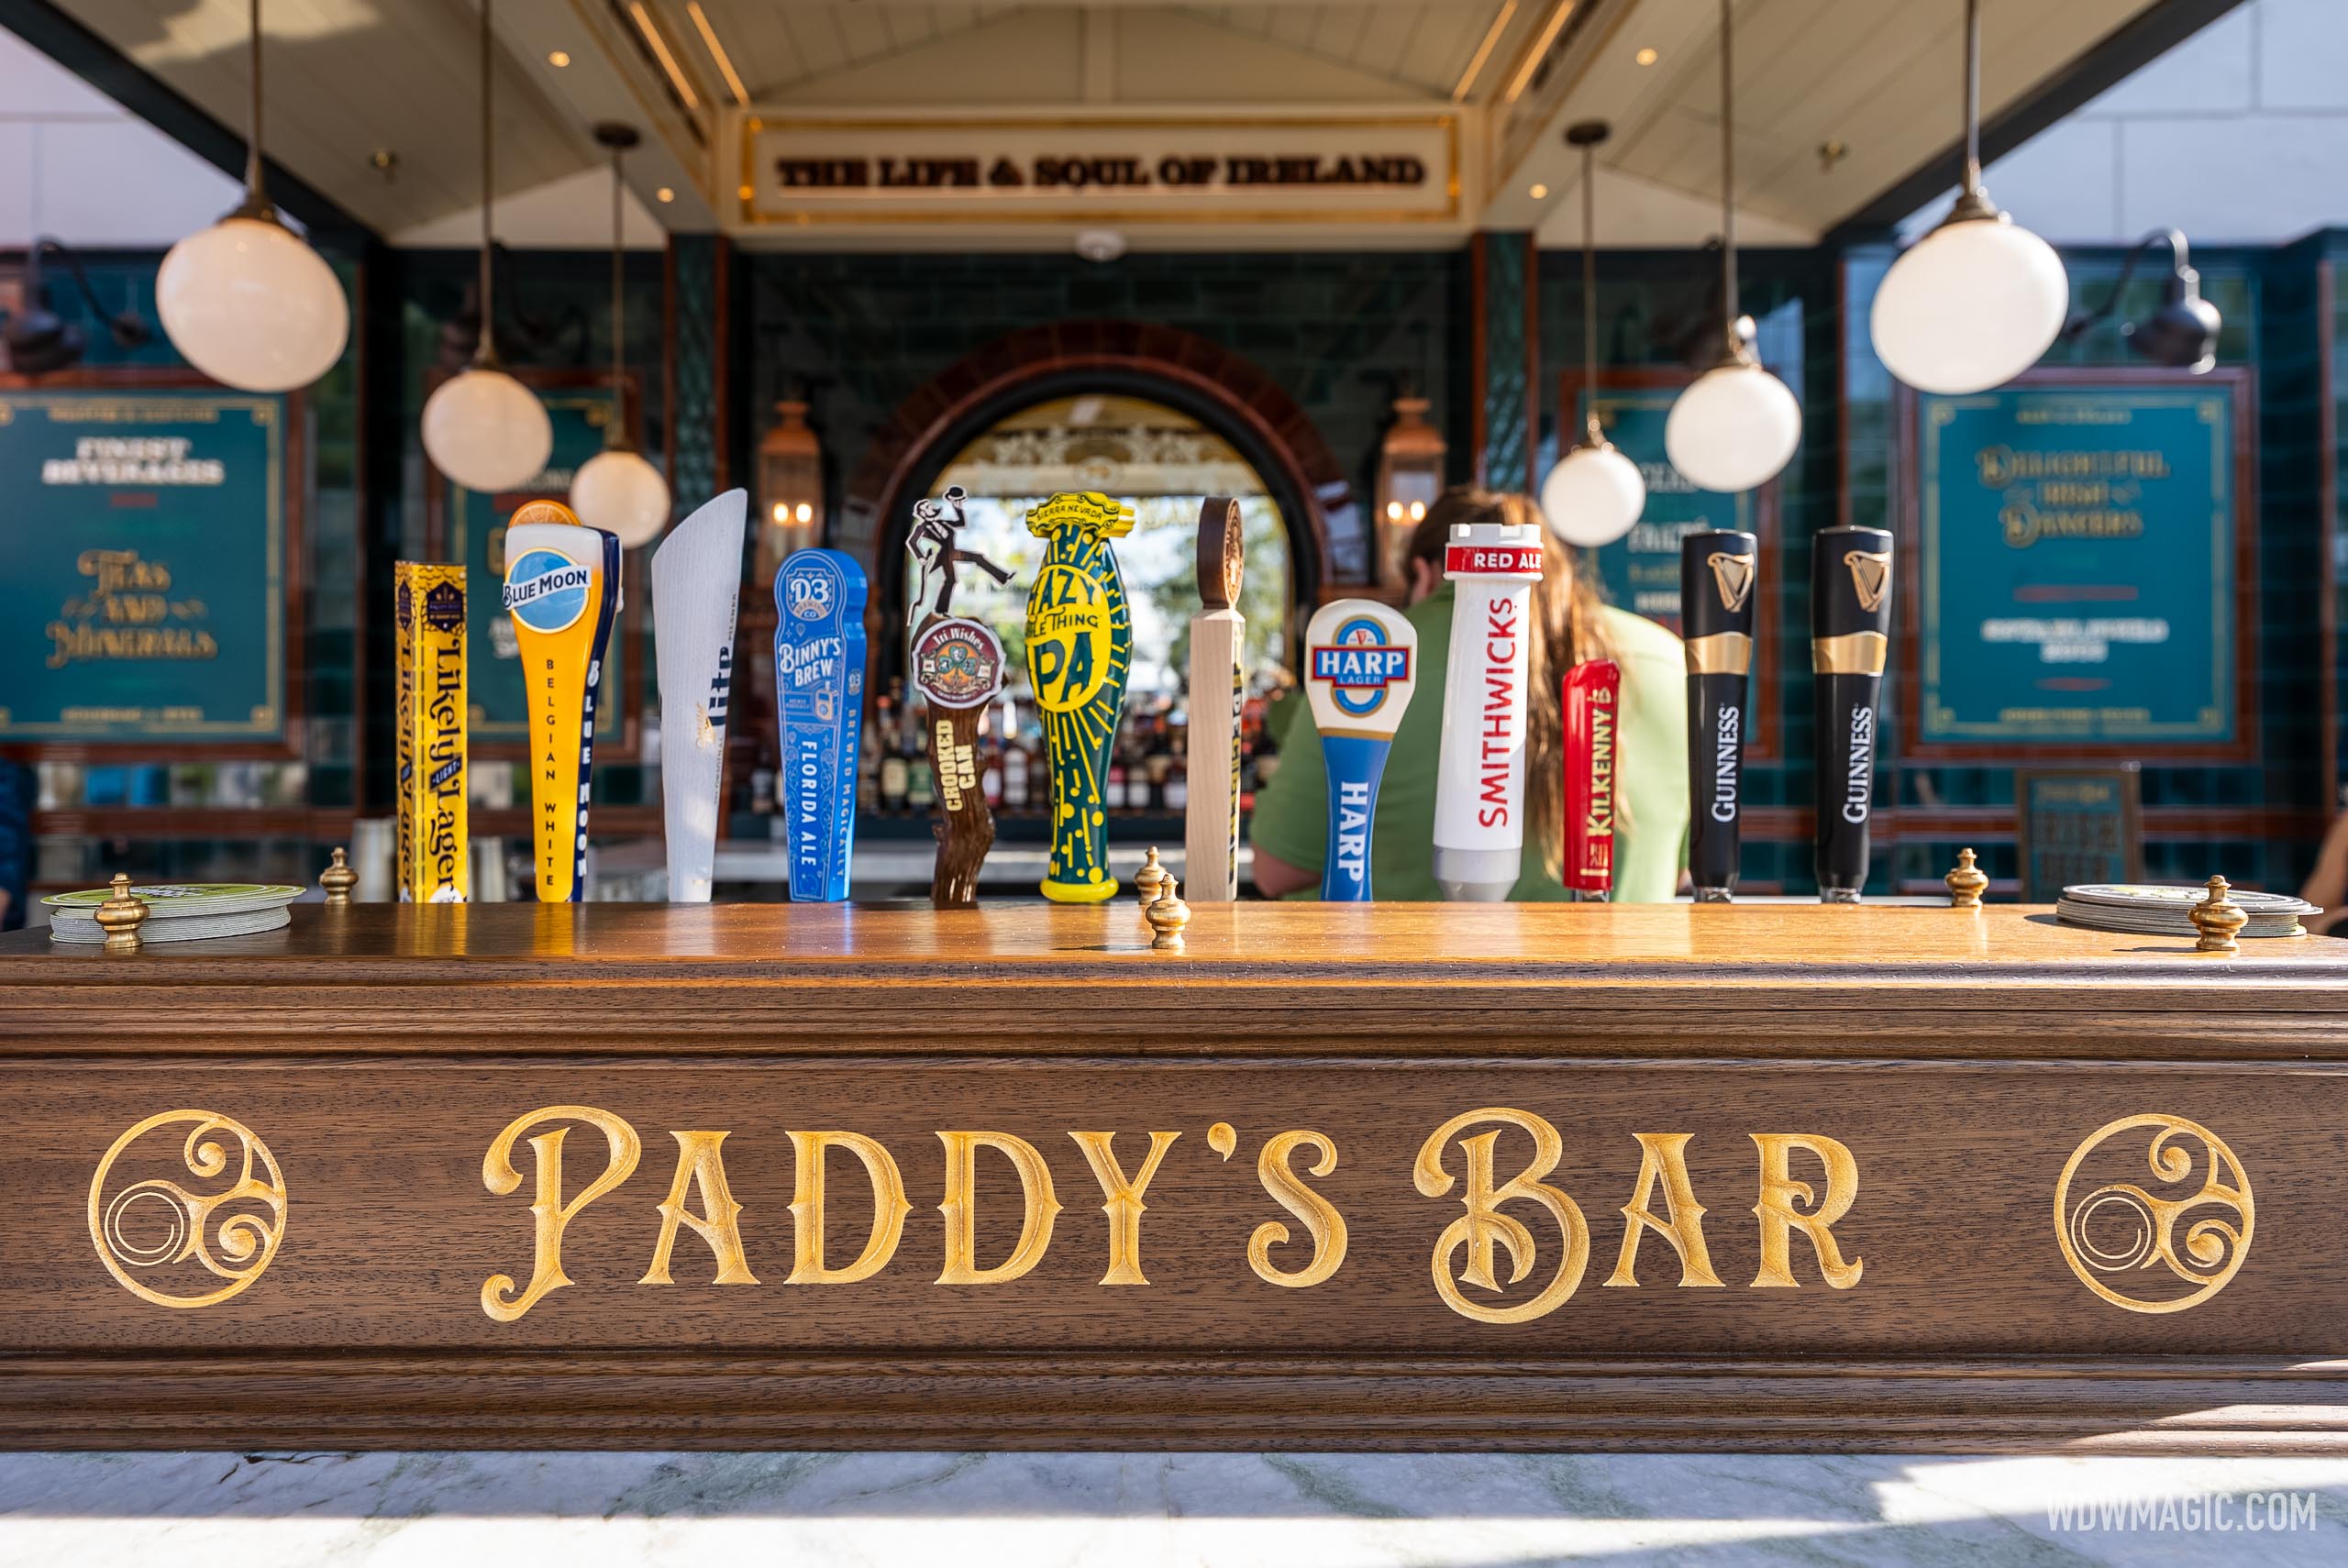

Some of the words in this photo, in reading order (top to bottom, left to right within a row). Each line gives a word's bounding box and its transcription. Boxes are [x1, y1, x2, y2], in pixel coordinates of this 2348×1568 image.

[775, 157, 869, 187] THE
[877, 157, 979, 187] LIFE
[989, 157, 1024, 187] &
[1034, 157, 1151, 189] SOUL
[1157, 156, 1217, 186] OF
[1227, 156, 1429, 186] IRELAND
[1037, 505, 1066, 521] SIERRA
[1068, 505, 1102, 521] NEVADA
[1474, 552, 1514, 569] RED
[1518, 552, 1542, 569] ALE
[503, 582, 537, 608] BLUE
[539, 569, 588, 595] MOON
[790, 578, 829, 604] D3
[950, 627, 984, 650] Wishes
[1045, 606, 1099, 632] THING
[779, 637, 842, 674] BINNY'S
[794, 658, 834, 688] BREW
[1321, 651, 1404, 675] HARP
[429, 638, 462, 763] Likely
[1339, 676, 1381, 685] LAGER
[546, 659, 556, 780] BELGIAN
[1479, 597, 1517, 828] SMITHWICKS
[844, 709, 857, 777] BREWED
[936, 719, 964, 812] CROOKED
[1711, 705, 1740, 823] GUINNESS
[1842, 705, 1873, 824] GUINNESS
[433, 761, 460, 785] LIGHT
[801, 740, 818, 823] FLORIDA
[954, 744, 977, 790] CAN
[1587, 708, 1613, 837] KILKENNY
[429, 779, 461, 892] Lager
[544, 803, 557, 886] WHITE
[801, 831, 817, 867] ALE
[1338, 781, 1369, 882] HARP
[480, 1104, 1348, 1323] PADDY'S
[1412, 1107, 1864, 1324] BAR
